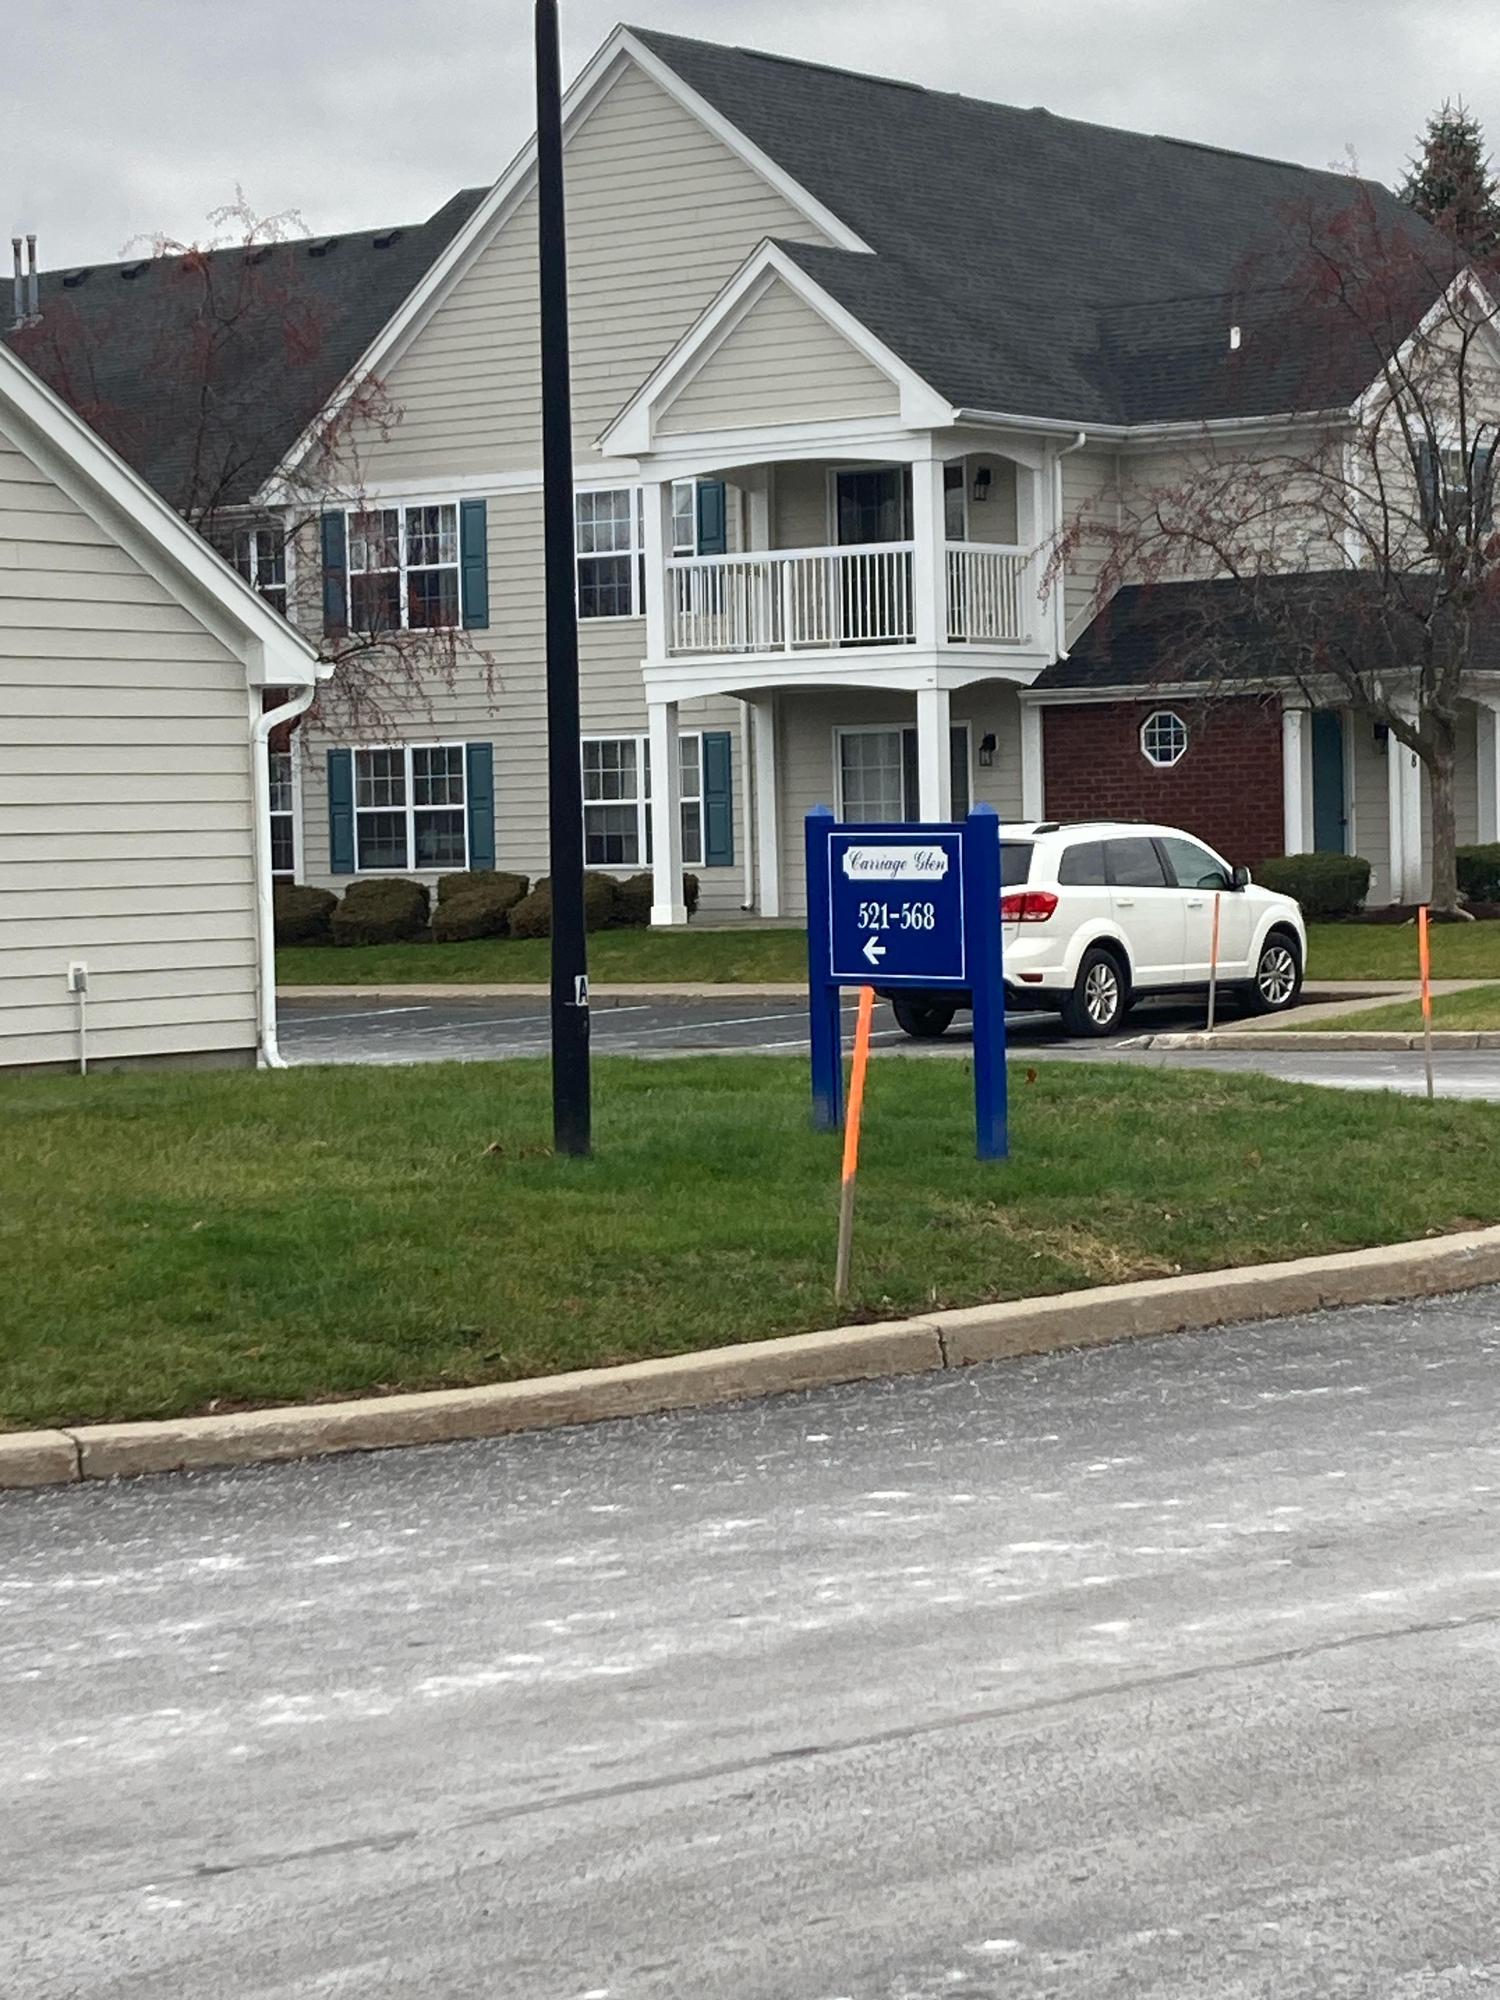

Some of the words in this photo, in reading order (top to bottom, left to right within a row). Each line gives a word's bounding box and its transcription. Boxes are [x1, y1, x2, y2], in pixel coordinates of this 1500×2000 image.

[849, 851, 907, 879] Carriage
[914, 850, 945, 871] Glen
[857, 902, 935, 930] 521-568
[579, 977, 588, 1003] A
